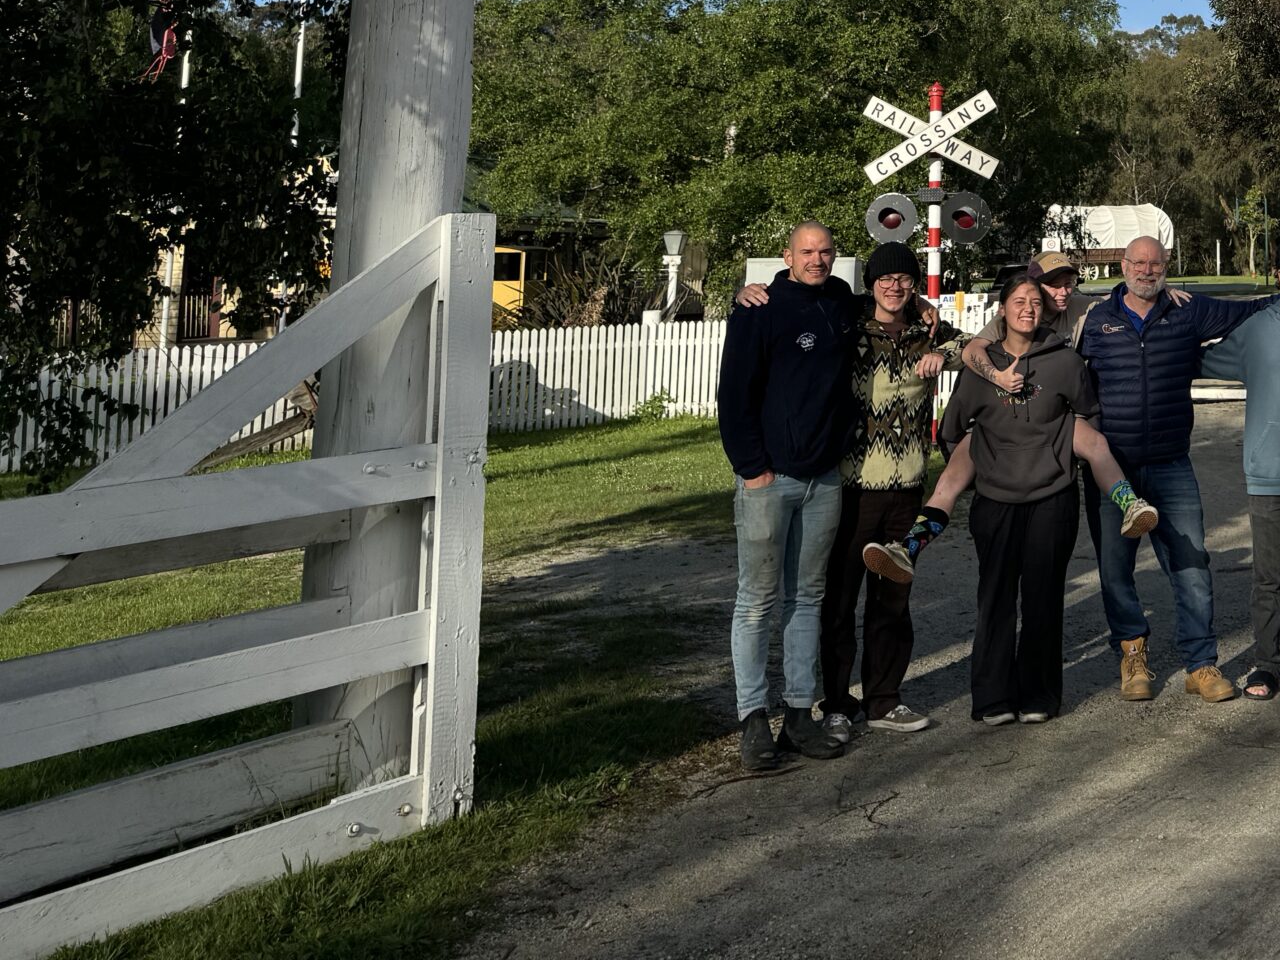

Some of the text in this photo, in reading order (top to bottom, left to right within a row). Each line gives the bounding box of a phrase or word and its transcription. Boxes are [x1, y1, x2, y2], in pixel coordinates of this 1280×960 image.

[871, 102, 991, 171] RAIL WAY
[875, 98, 986, 176] CROSSING
